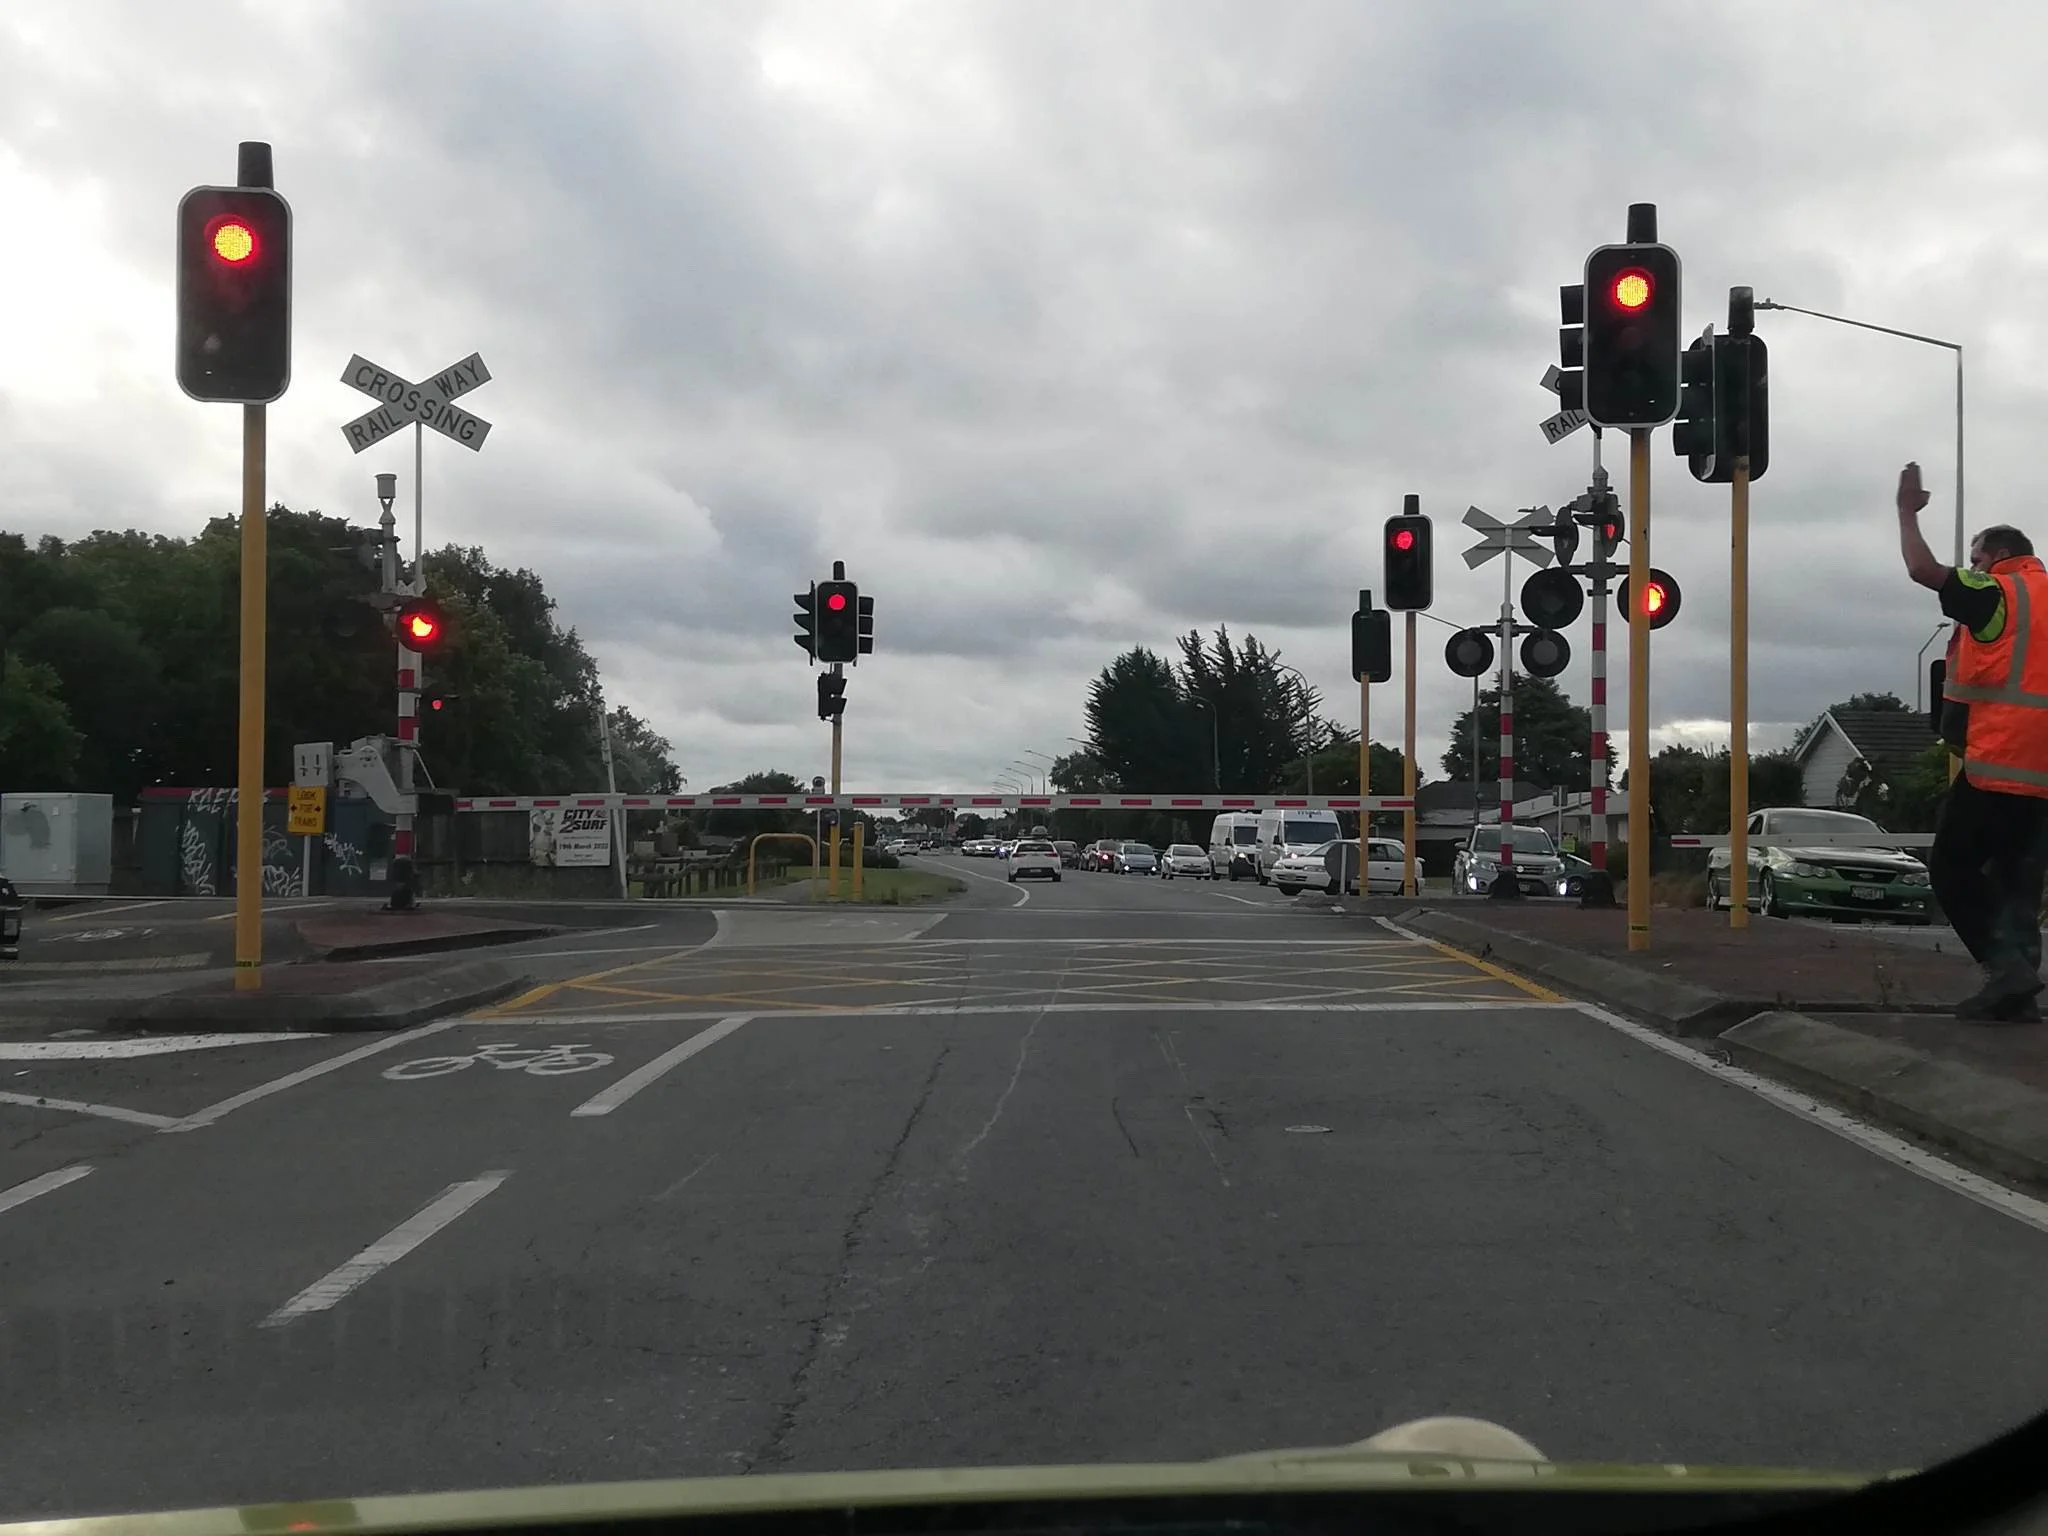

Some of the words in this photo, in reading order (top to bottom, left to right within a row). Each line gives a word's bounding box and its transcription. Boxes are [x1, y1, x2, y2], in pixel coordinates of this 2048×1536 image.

[350, 408, 403, 446] RAIL
[434, 360, 481, 397] WAY
[355, 365, 477, 440] CROSSING
[1547, 409, 1587, 438] RAIL
[564, 808, 594, 820] CITY
